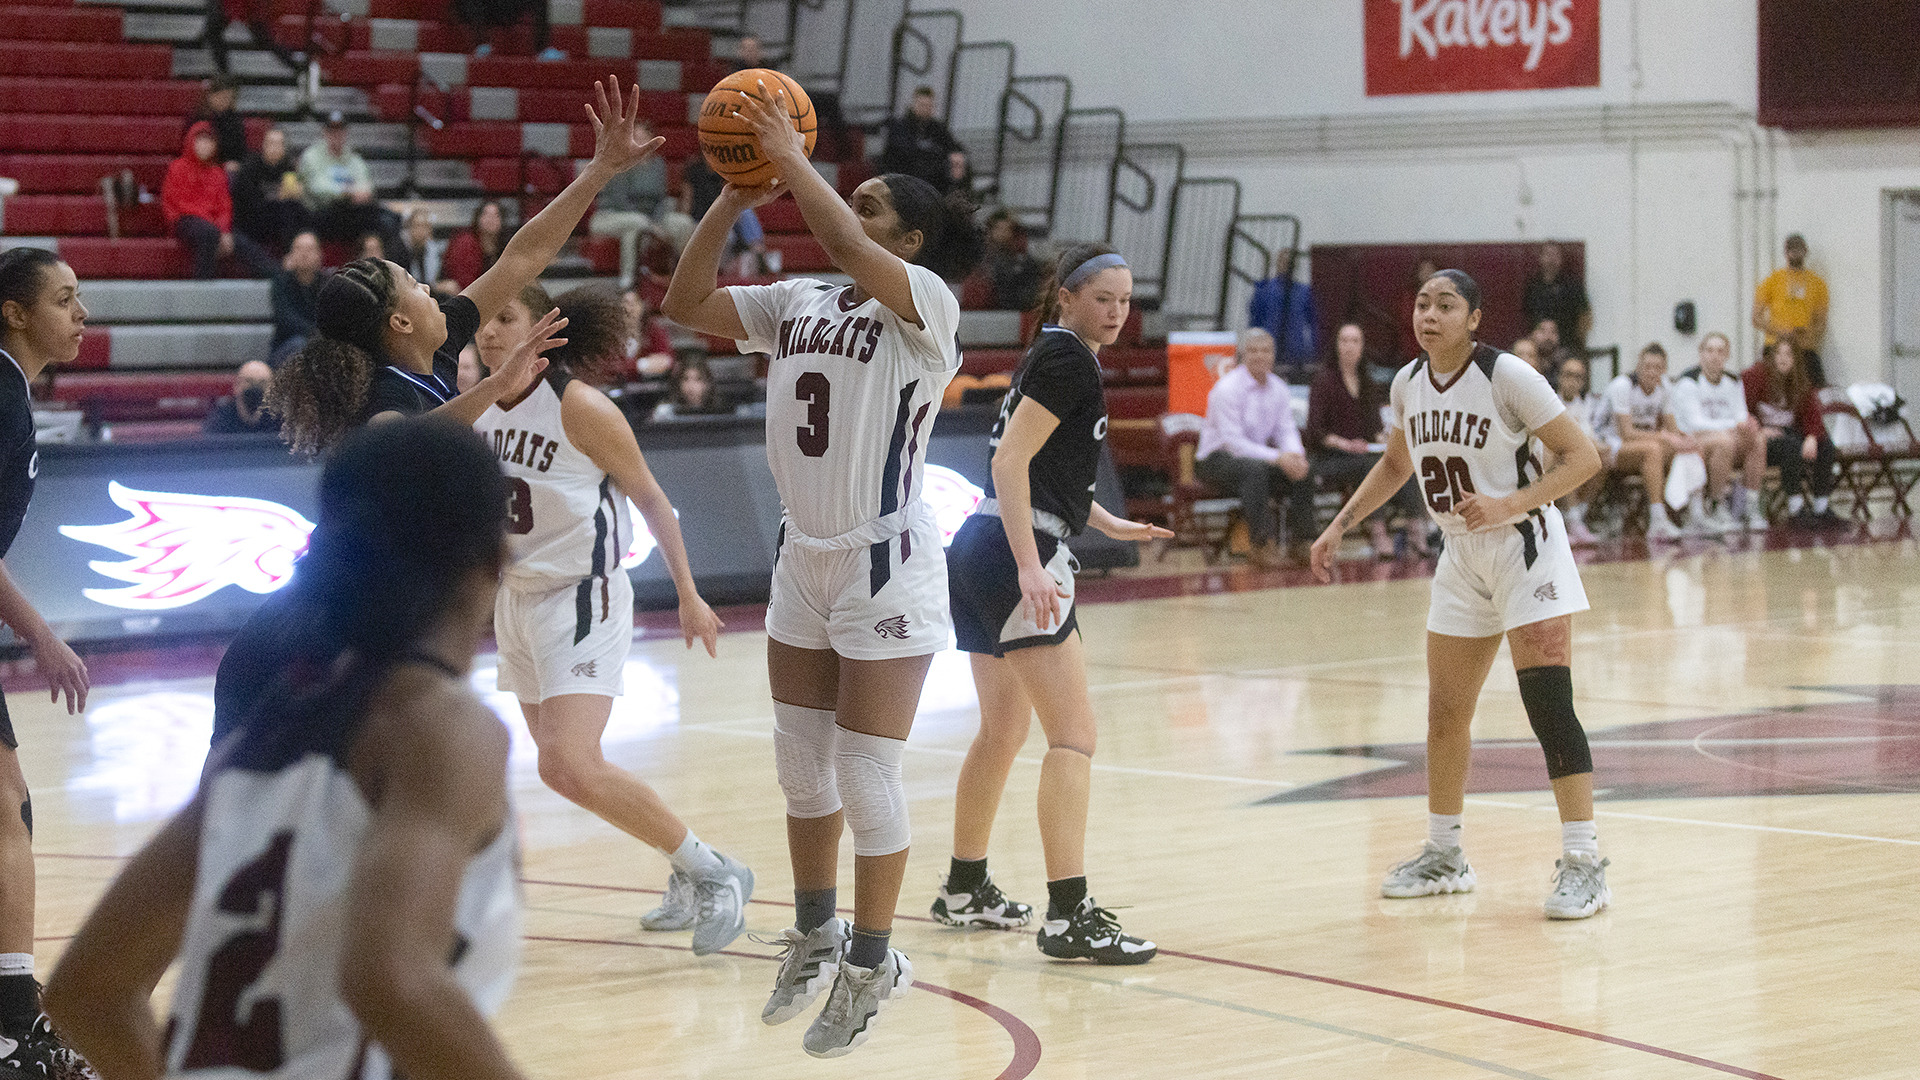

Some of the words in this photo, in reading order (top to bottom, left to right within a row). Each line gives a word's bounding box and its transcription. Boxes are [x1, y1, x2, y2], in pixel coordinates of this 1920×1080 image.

[776, 315, 884, 364] WILDCATS
[795, 371, 831, 458] 3
[1421, 455, 1475, 514] 20
[181, 825, 296, 1075] 2
